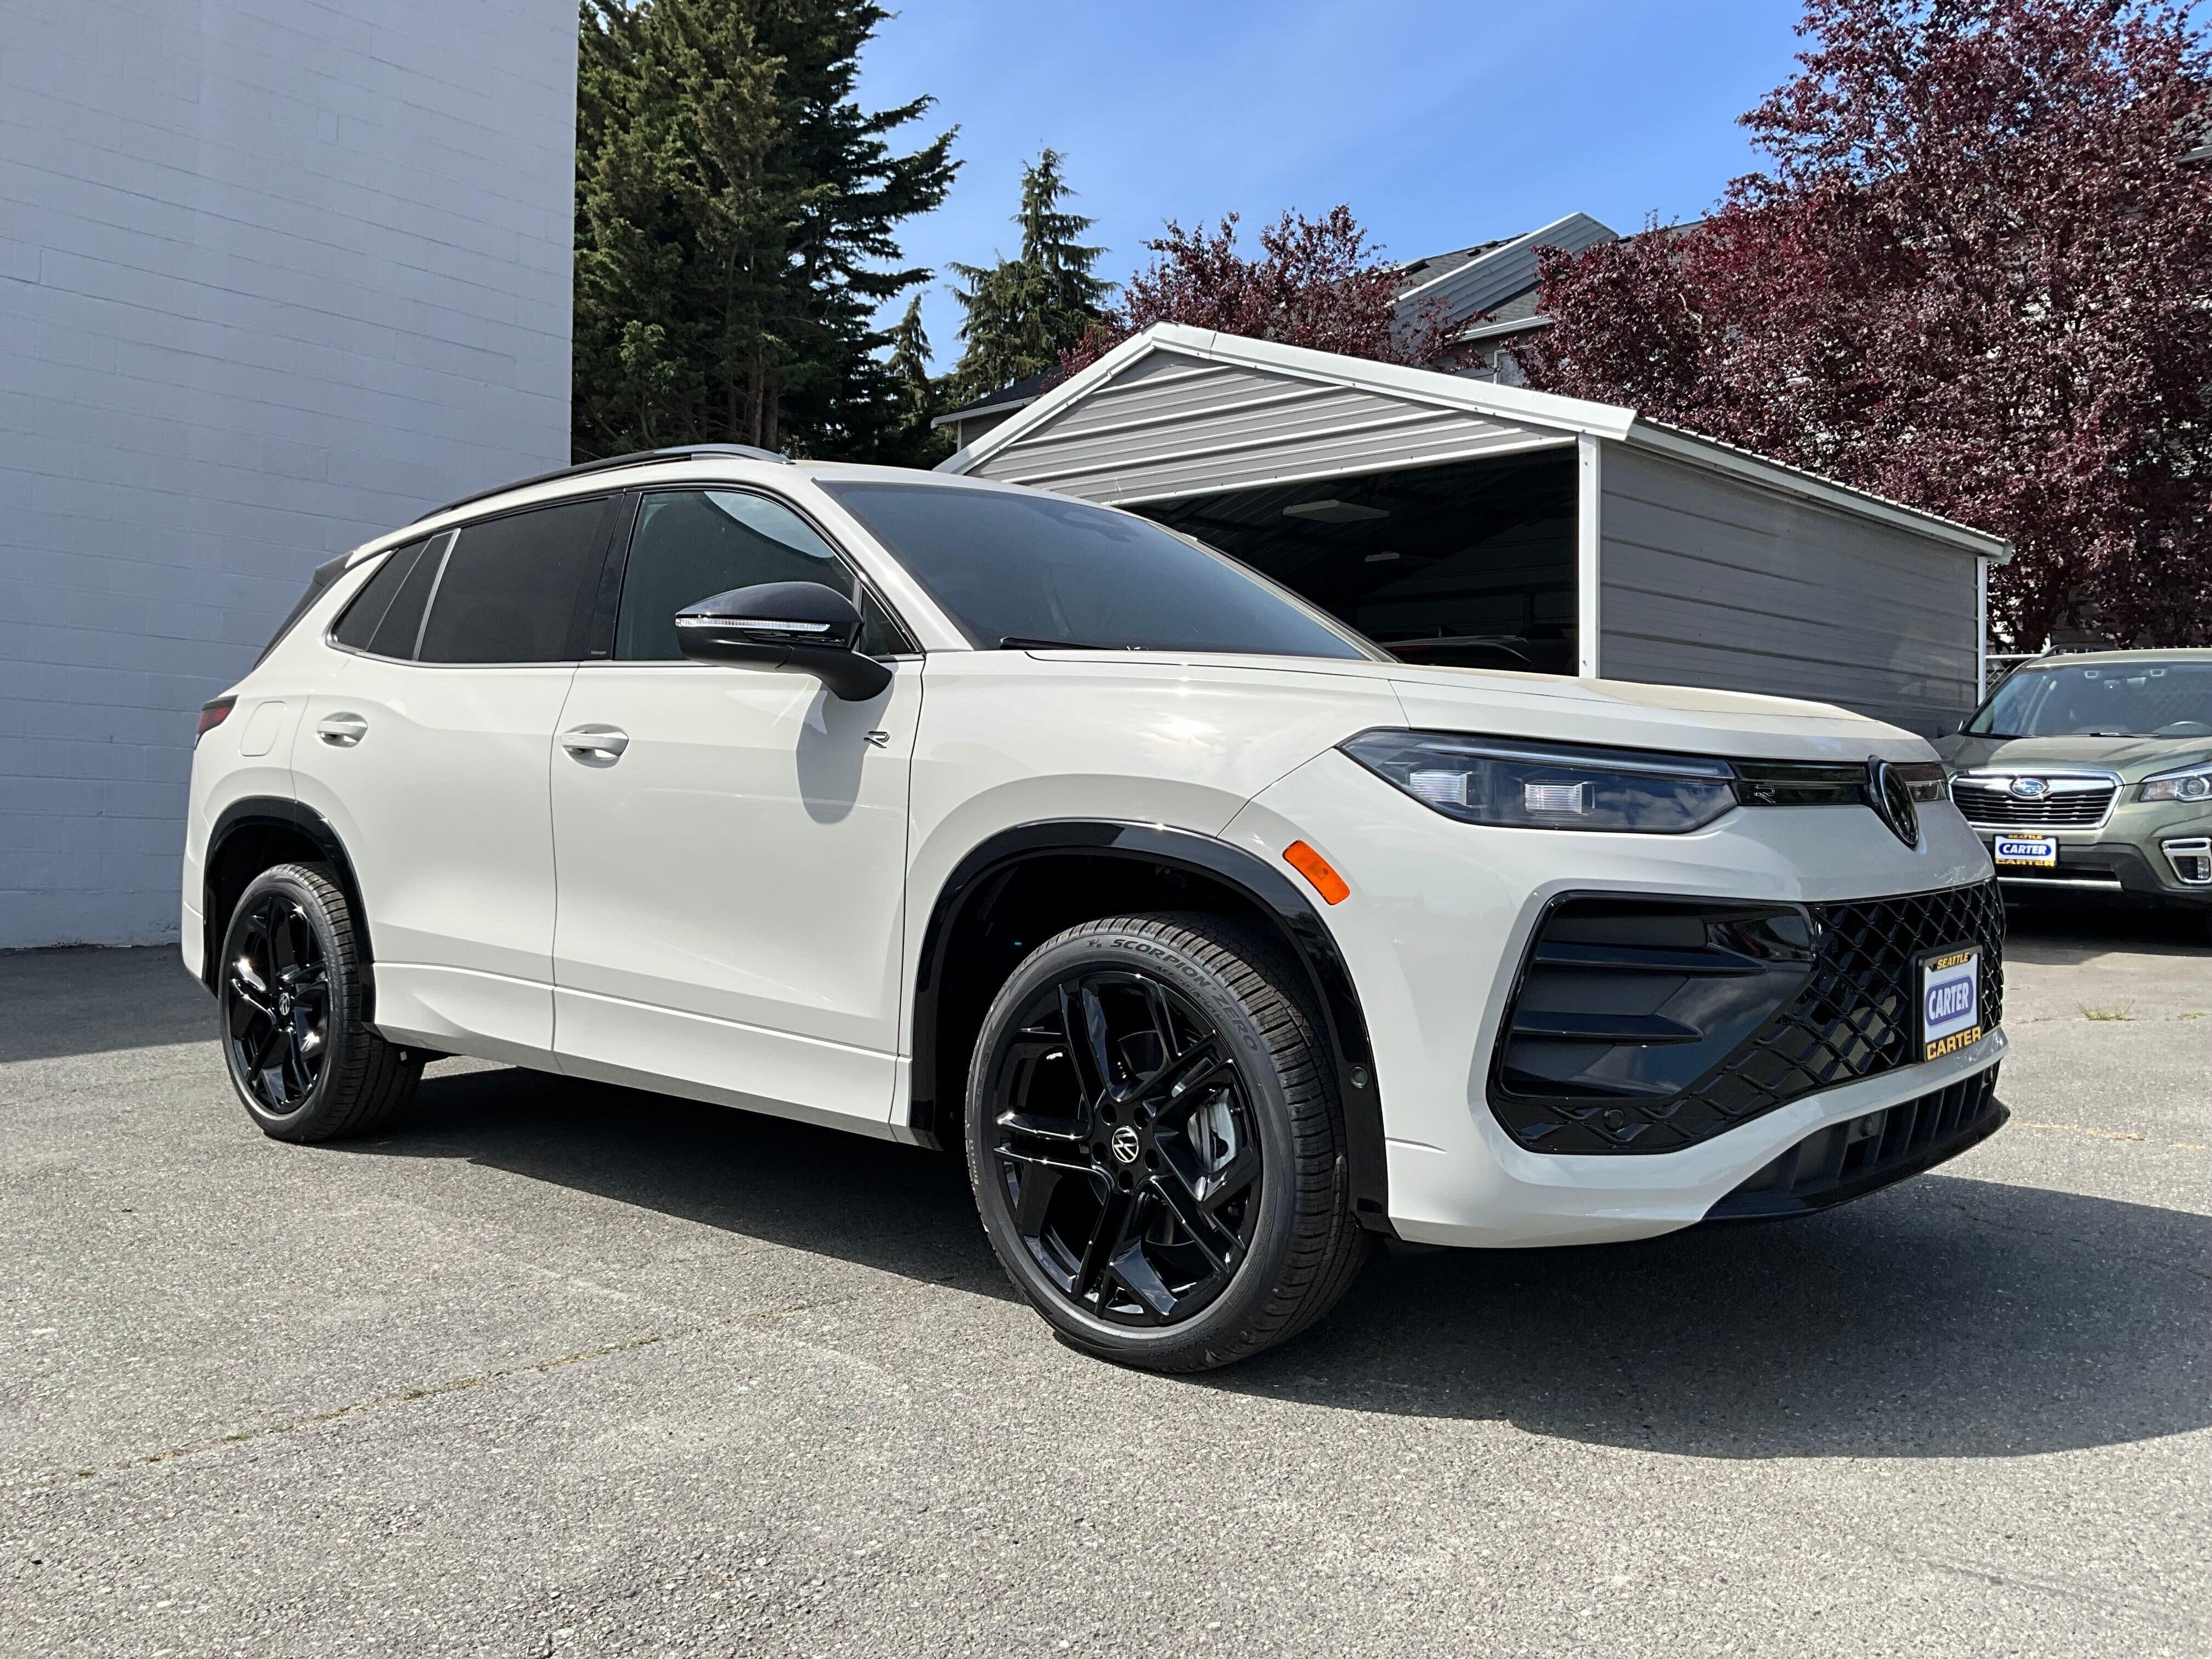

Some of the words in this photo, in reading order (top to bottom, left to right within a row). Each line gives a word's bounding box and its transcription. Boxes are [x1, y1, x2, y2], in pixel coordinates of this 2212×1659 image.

[2002, 844, 2047, 854] CARTER
[1937, 952, 1969, 969] SEATTLE
[1110, 939, 1211, 987] SCORPION
[1211, 994, 1258, 1051] ZERO
[1928, 982, 1969, 1019] CARTER
[1926, 1026, 1982, 1060] CARTER
